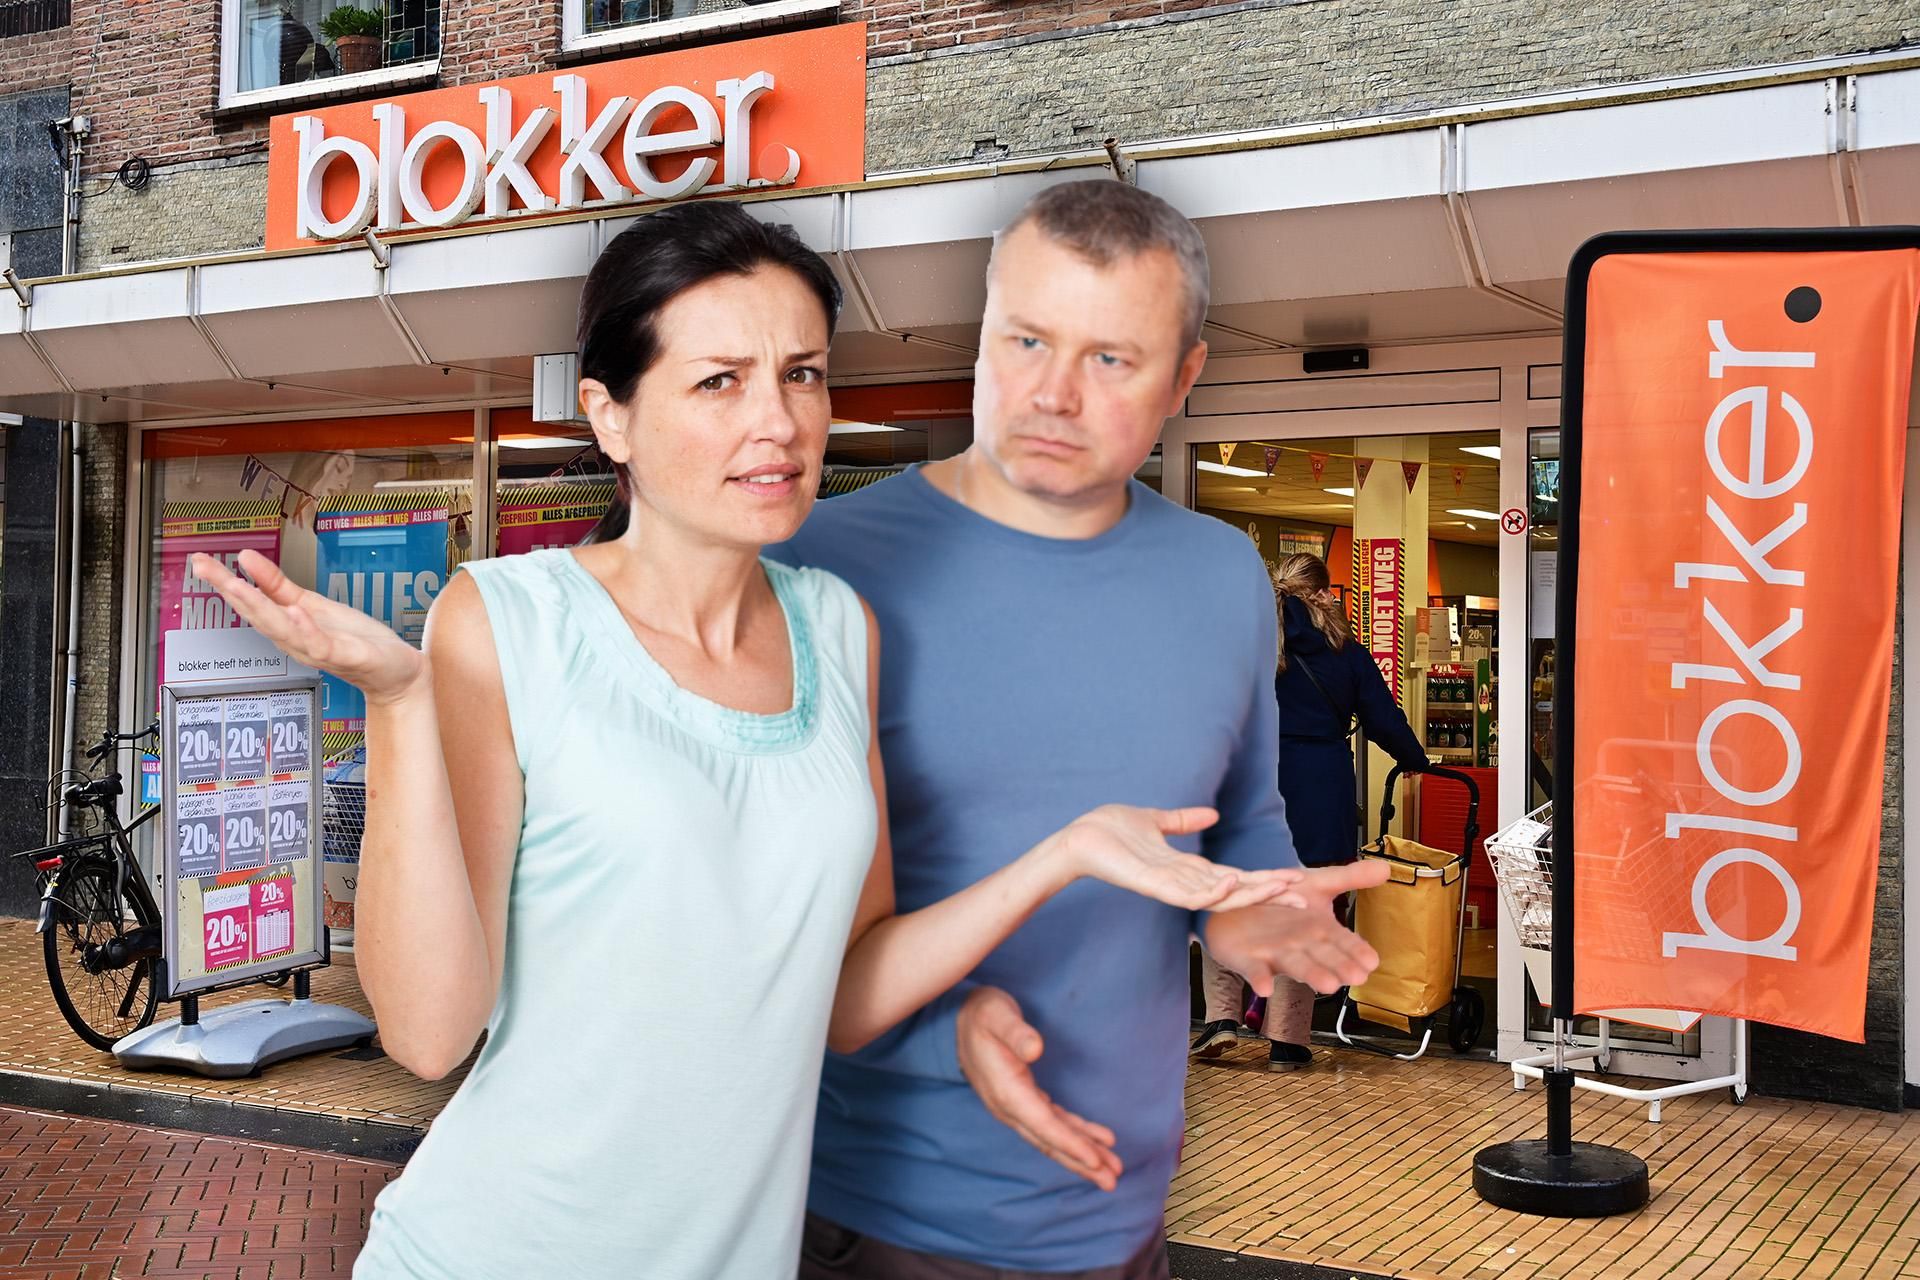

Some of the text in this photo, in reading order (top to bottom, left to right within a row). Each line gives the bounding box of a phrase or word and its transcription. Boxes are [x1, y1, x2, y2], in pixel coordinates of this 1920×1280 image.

[333, 518, 349, 529] WEG
[353, 512, 409, 528] ALLES MOET WEG
[412, 509, 449, 522] ALLES MOE
[541, 510, 563, 521] ALLES
[1374, 546, 1395, 594] WEG
[1373, 597, 1394, 653] MOET
[178, 655, 281, 672] blokker heeft het in huis
[180, 728, 221, 763] 20%
[227, 727, 266, 760] 20%
[273, 721, 309, 753] 20%
[179, 822, 220, 857] 20%
[226, 816, 265, 850] 20%
[271, 810, 307, 842] 20%
[261, 882, 285, 902] 20%
[206, 914, 247, 951] 20%
